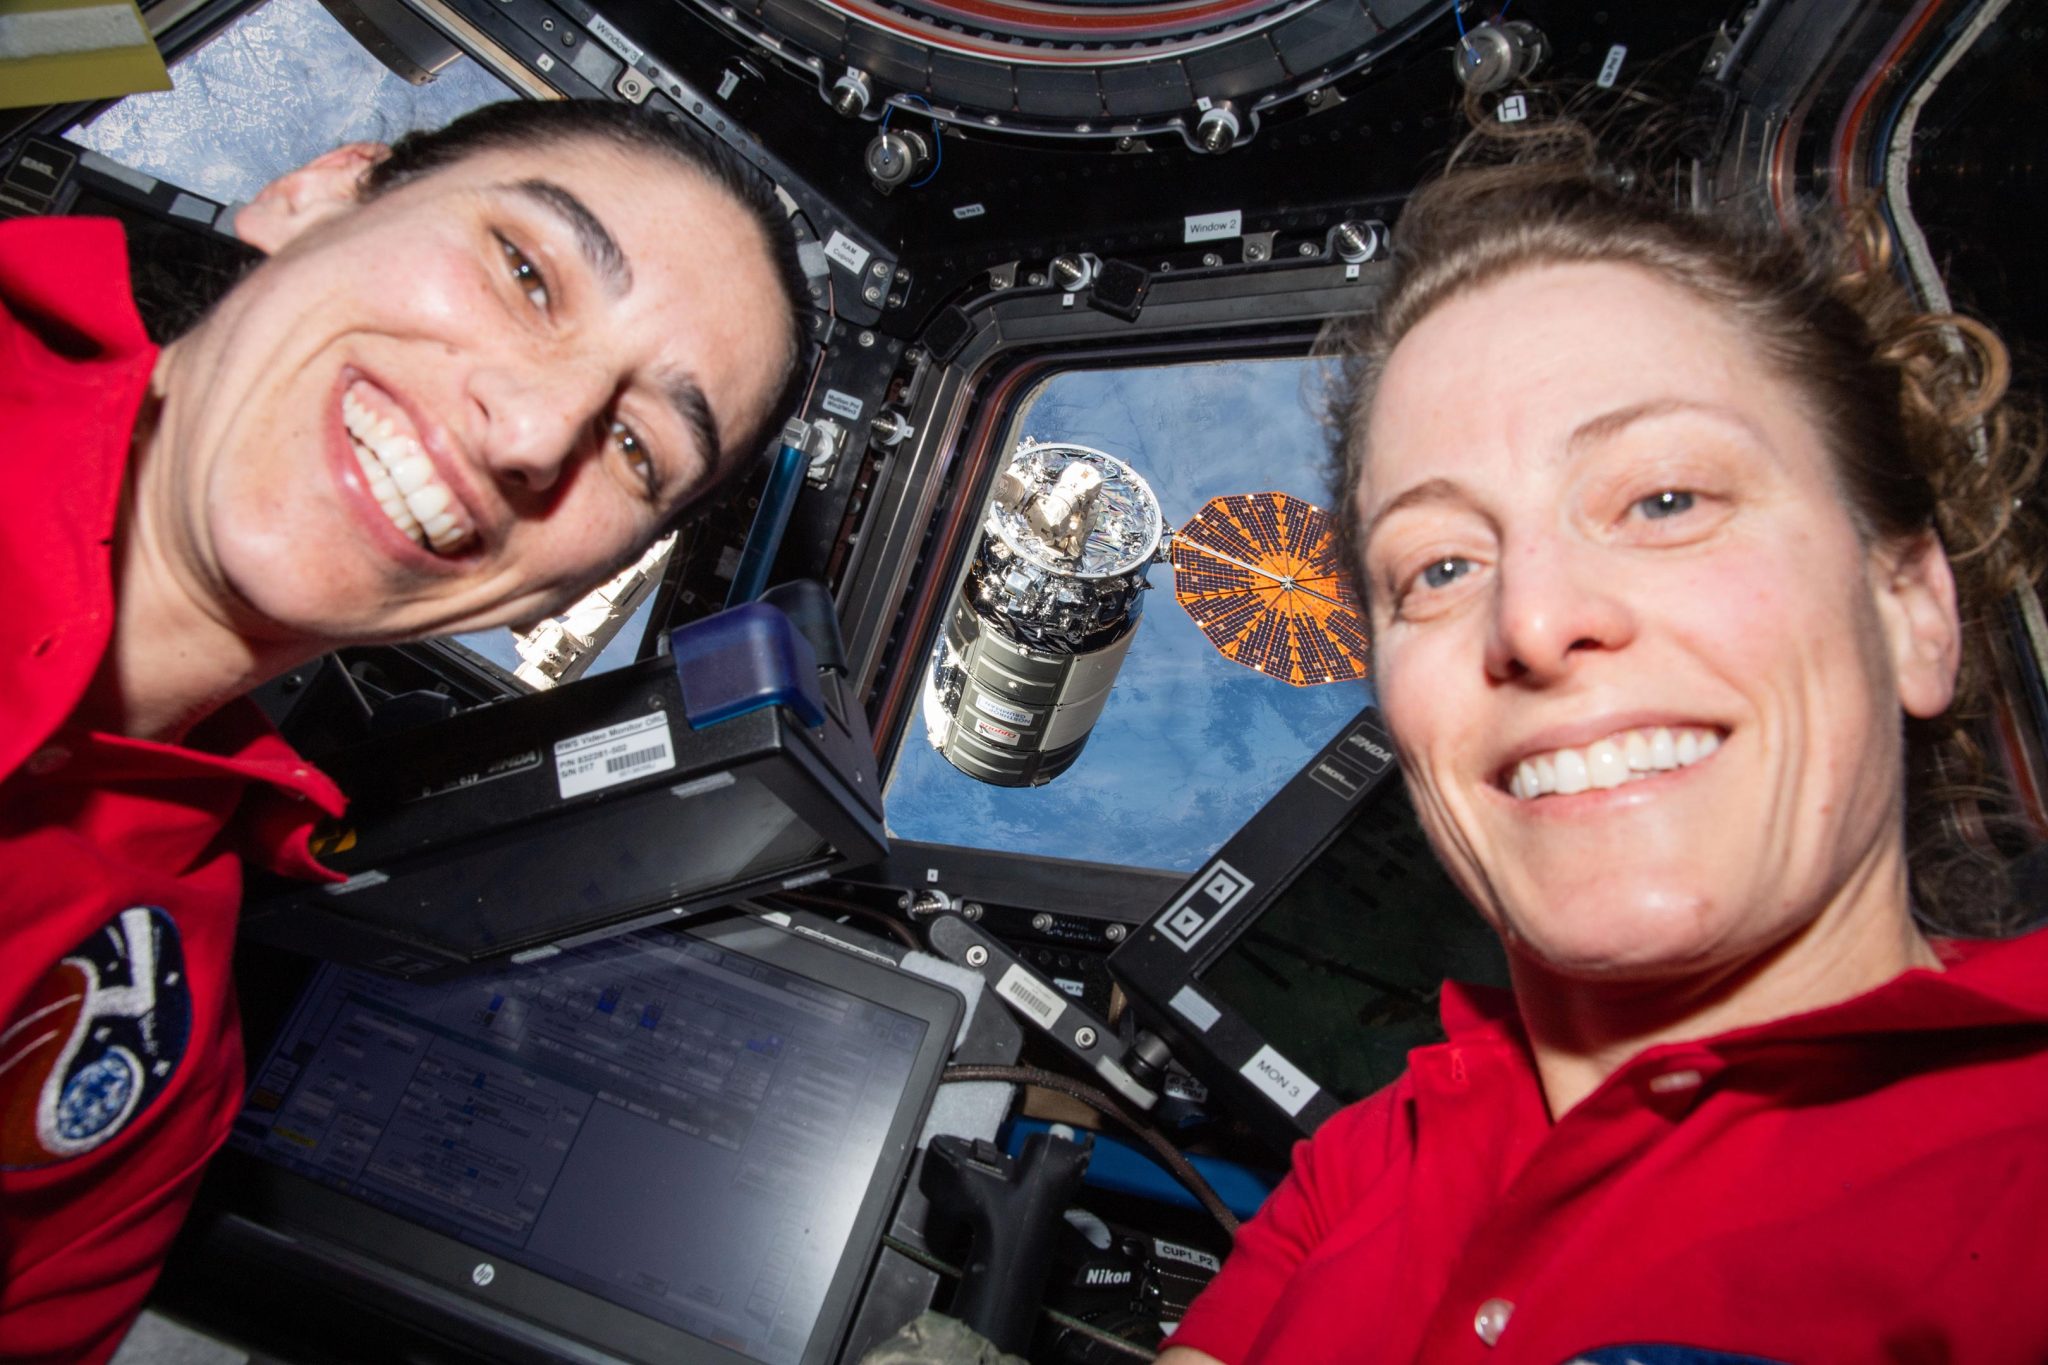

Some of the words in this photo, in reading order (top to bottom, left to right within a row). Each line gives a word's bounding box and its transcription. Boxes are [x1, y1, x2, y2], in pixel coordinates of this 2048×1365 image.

[595, 21, 631, 55] Window
[630, 51, 639, 61] 3
[541, 58, 549, 67] A
[1503, 98, 1521, 119] H
[1190, 222, 1227, 234] Window
[1230, 219, 1237, 229] 2
[833, 248, 855, 266] Cupola
[841, 241, 857, 255] RAM
[582, 729, 606, 745] Video
[609, 720, 643, 738] Monitor
[1256, 1060, 1290, 1088] MON
[1289, 1085, 1300, 1098] 3
[1086, 1269, 1132, 1284] Nikon
